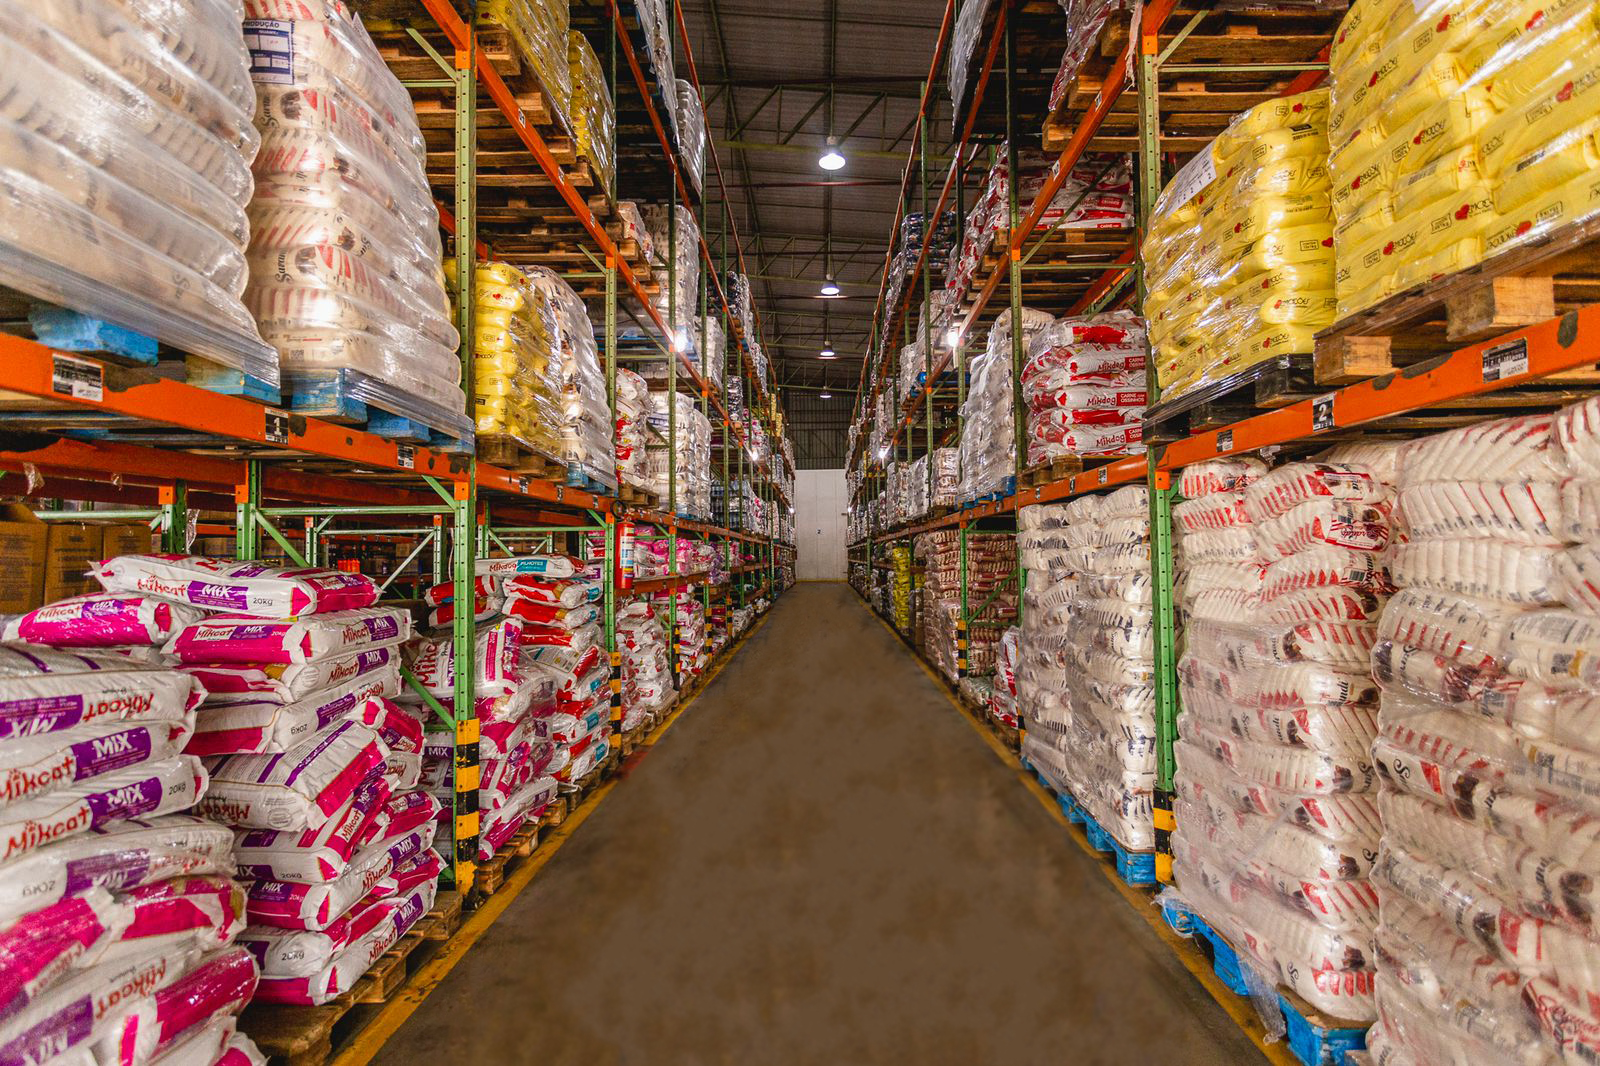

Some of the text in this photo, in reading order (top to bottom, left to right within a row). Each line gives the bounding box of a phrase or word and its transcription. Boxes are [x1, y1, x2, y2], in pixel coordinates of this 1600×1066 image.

[1087, 395, 1116, 407] Mikdog
[1318, 403, 1327, 422] 2
[273, 417, 282, 435] 1
[1096, 434, 1125, 447] Mikdog
[137, 575, 273, 607] Mikcat MIX 20kg
[39, 605, 82, 621] Mikcat
[195, 626, 235, 640] Mikcat
[243, 625, 265, 633] MIX
[342, 616, 390, 644] Mikcat MIX
[327, 651, 382, 684] Mikcat MIX
[83, 693, 154, 723] Mikcat
[290, 723, 308, 735] 20kg
[428, 746, 448, 757] MIX
[0, 755, 75, 801] Mikcat
[92, 732, 130, 758] MIX
[3, 782, 187, 860] Mikcat MIX 20kg
[340, 809, 363, 840] Mikcat
[361, 838, 414, 892] Mikcat MIX
[22, 879, 56, 897] 20kg
[261, 881, 284, 893] MIX
[368, 898, 416, 963] Mikcat MIX
[280, 952, 305, 961] 20kg
[95, 957, 168, 1020] Mikcat
